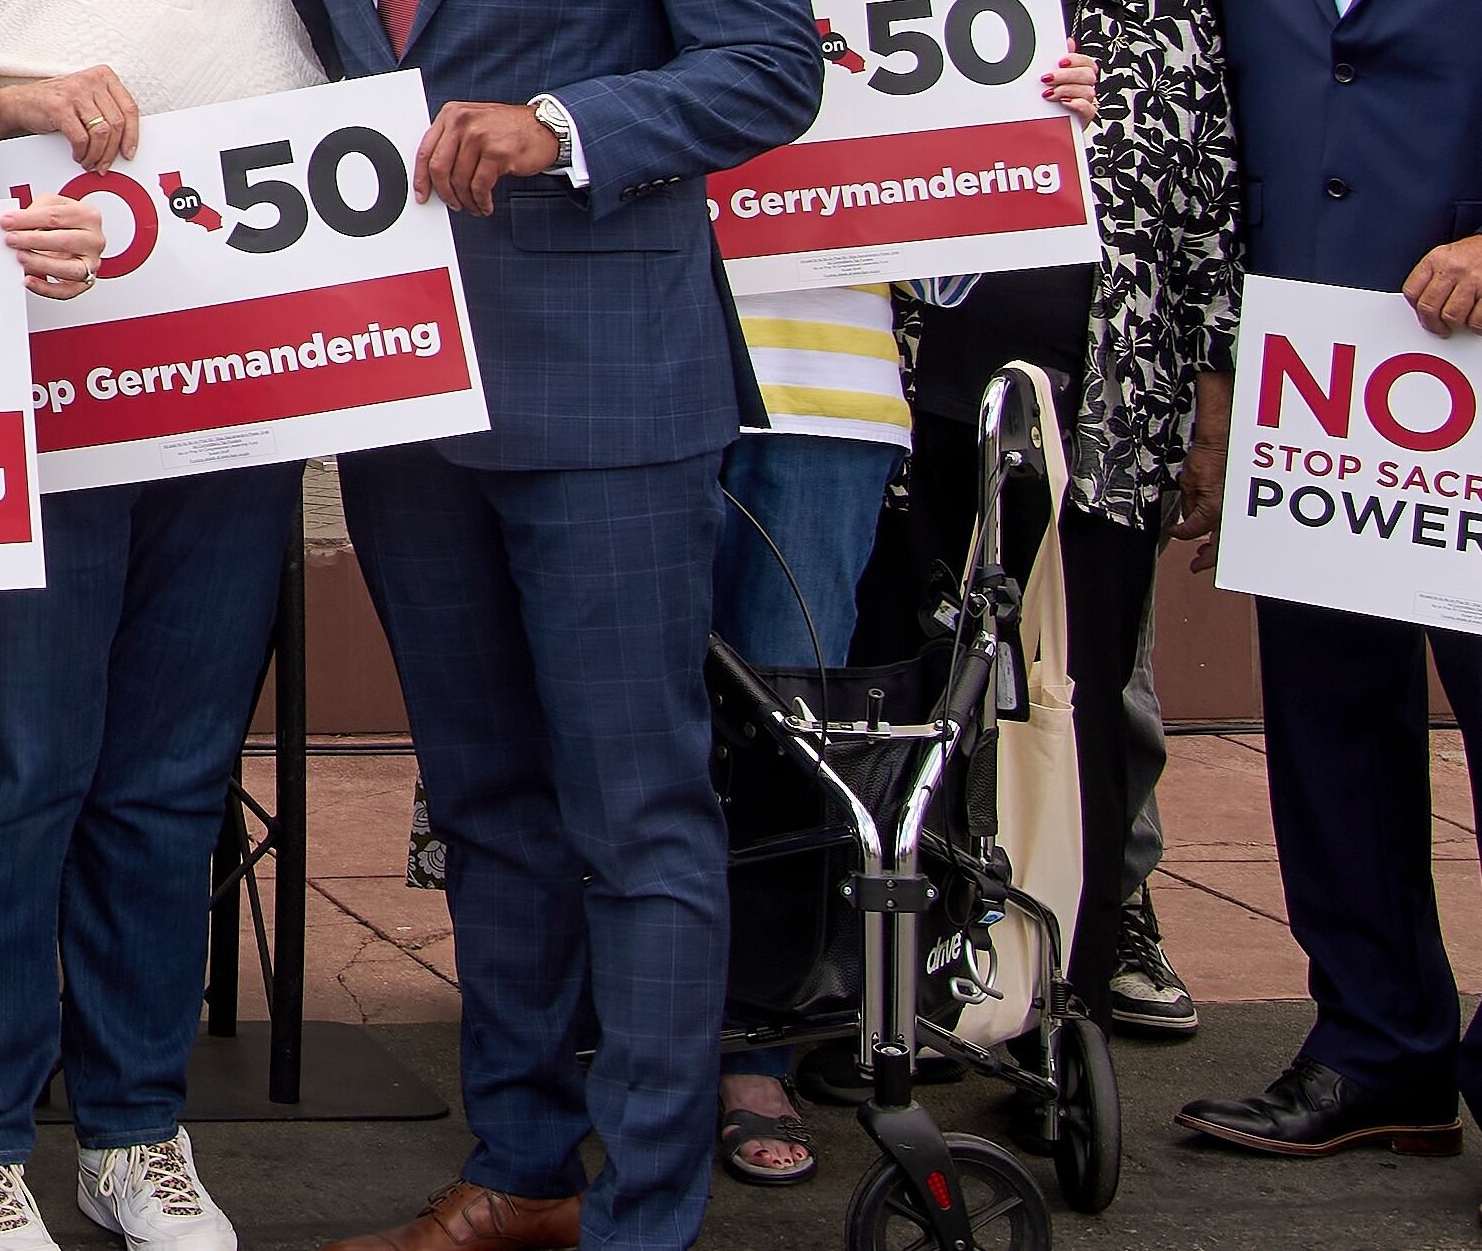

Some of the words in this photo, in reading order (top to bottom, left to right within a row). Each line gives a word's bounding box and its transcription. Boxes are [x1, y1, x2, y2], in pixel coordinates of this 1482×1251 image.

[821, 39, 845, 53] on
[173, 193, 198, 211] on
[220, 126, 408, 254] 50
[730, 160, 1060, 219] Gerrymandering
[31, 380, 76, 413] op
[86, 320, 441, 400] Gerrymandering
[1257, 333, 1476, 452] NO
[1252, 441, 1362, 480] STOP
[1247, 477, 1482, 552] POWER
[926, 932, 962, 975] drive
